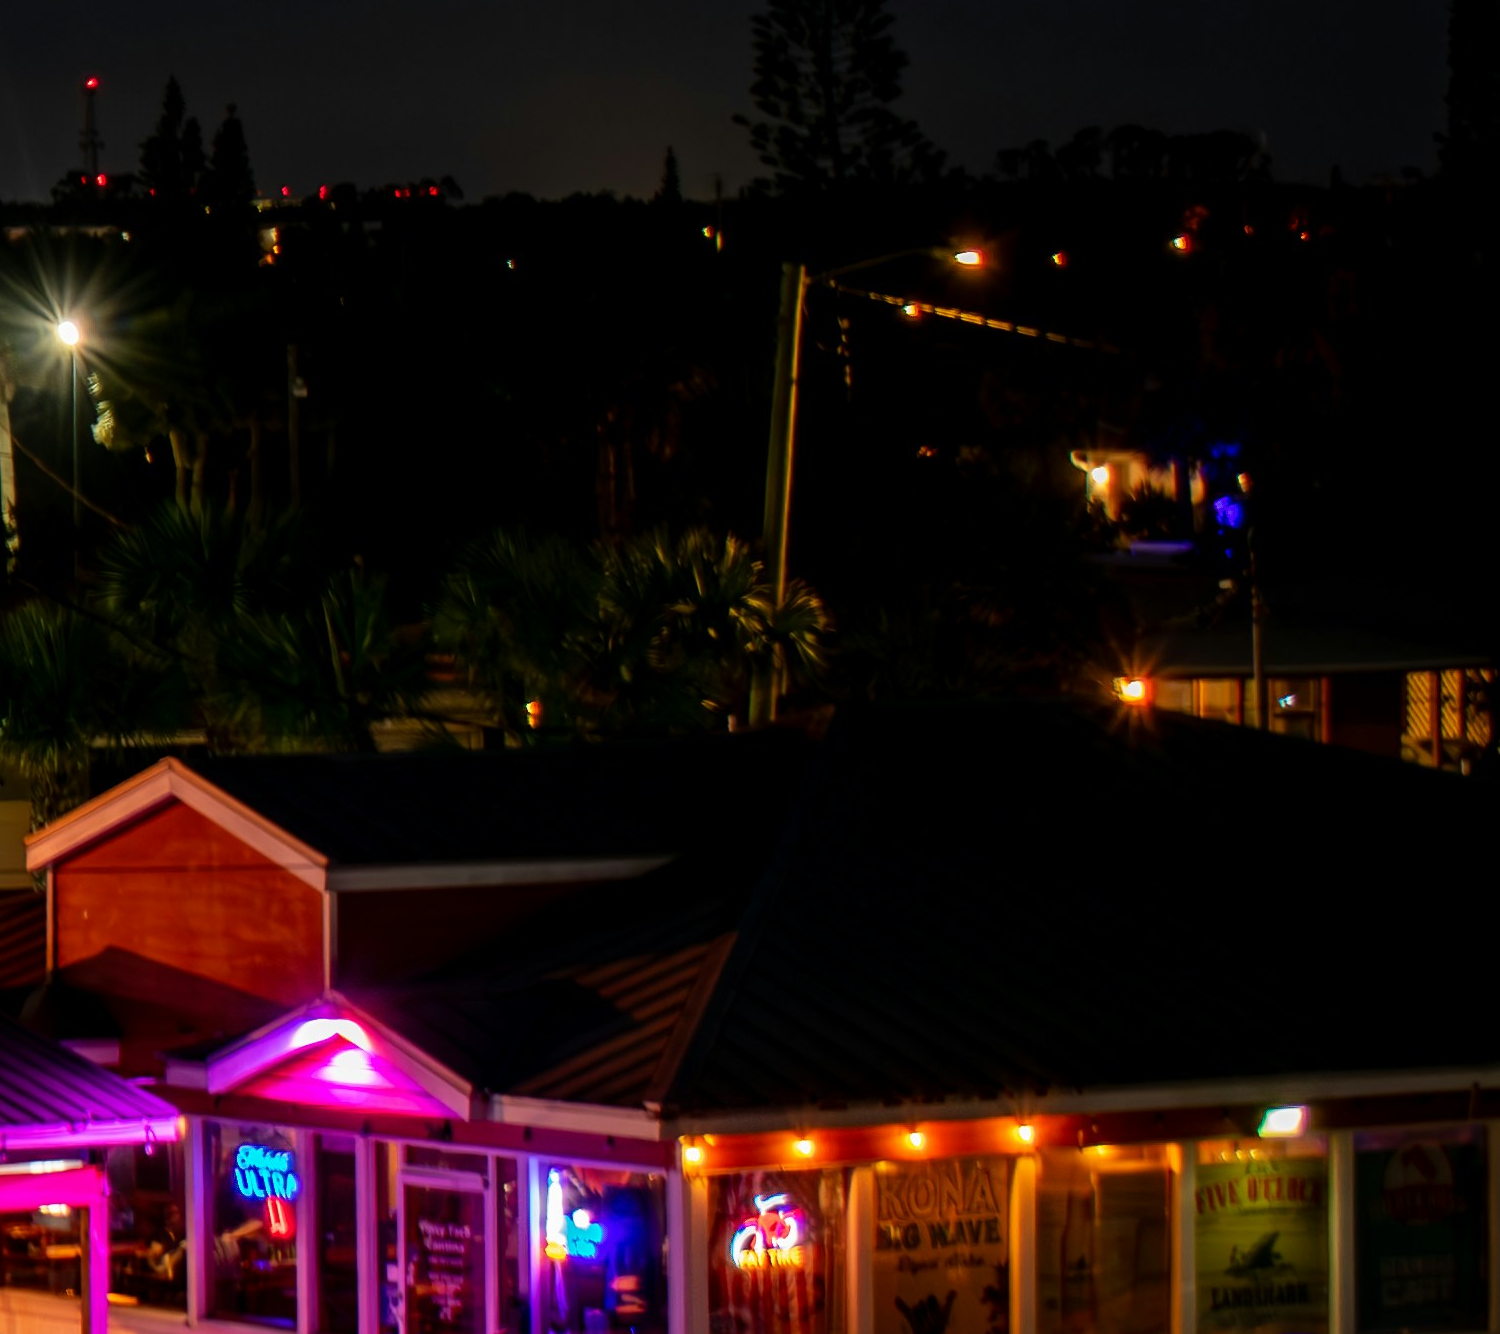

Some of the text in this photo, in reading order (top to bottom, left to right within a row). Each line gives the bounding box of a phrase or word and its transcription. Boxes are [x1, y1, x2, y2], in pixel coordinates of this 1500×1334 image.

[235, 1168, 297, 1199] ULTRA
[876, 1165, 1000, 1220] KONA
[930, 1216, 1001, 1249] WAVE
